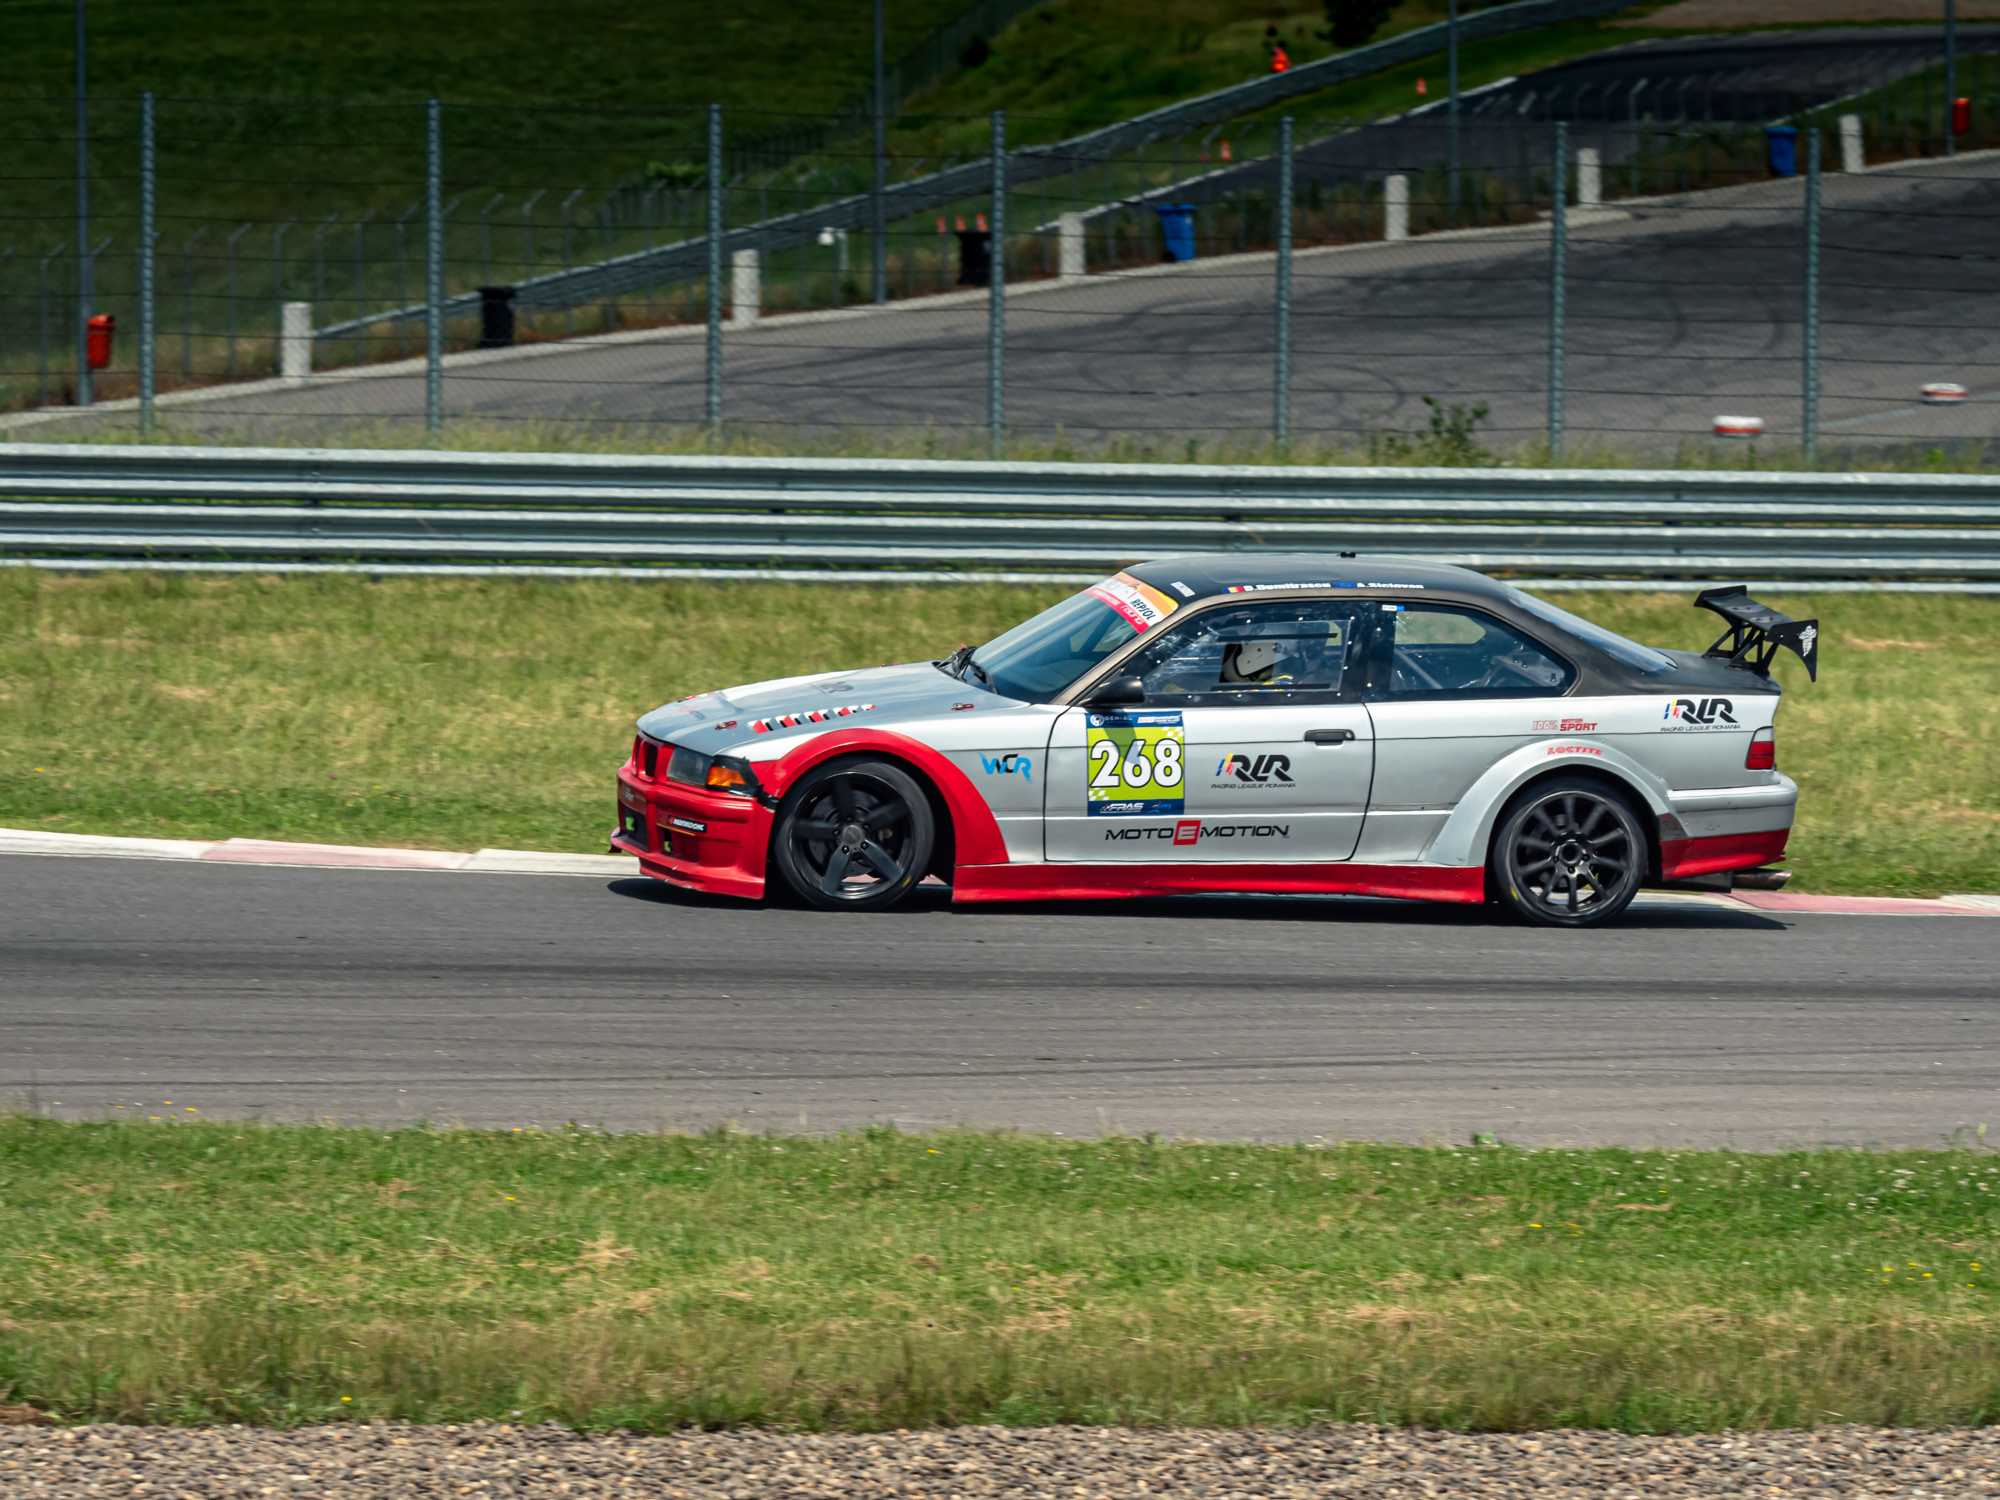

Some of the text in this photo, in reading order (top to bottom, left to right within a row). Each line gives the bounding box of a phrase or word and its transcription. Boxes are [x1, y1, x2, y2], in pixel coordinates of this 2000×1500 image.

[1131, 598, 1156, 621] REPSOL
[1560, 723, 1598, 732] SPORT
[1091, 738, 1184, 789] 268
